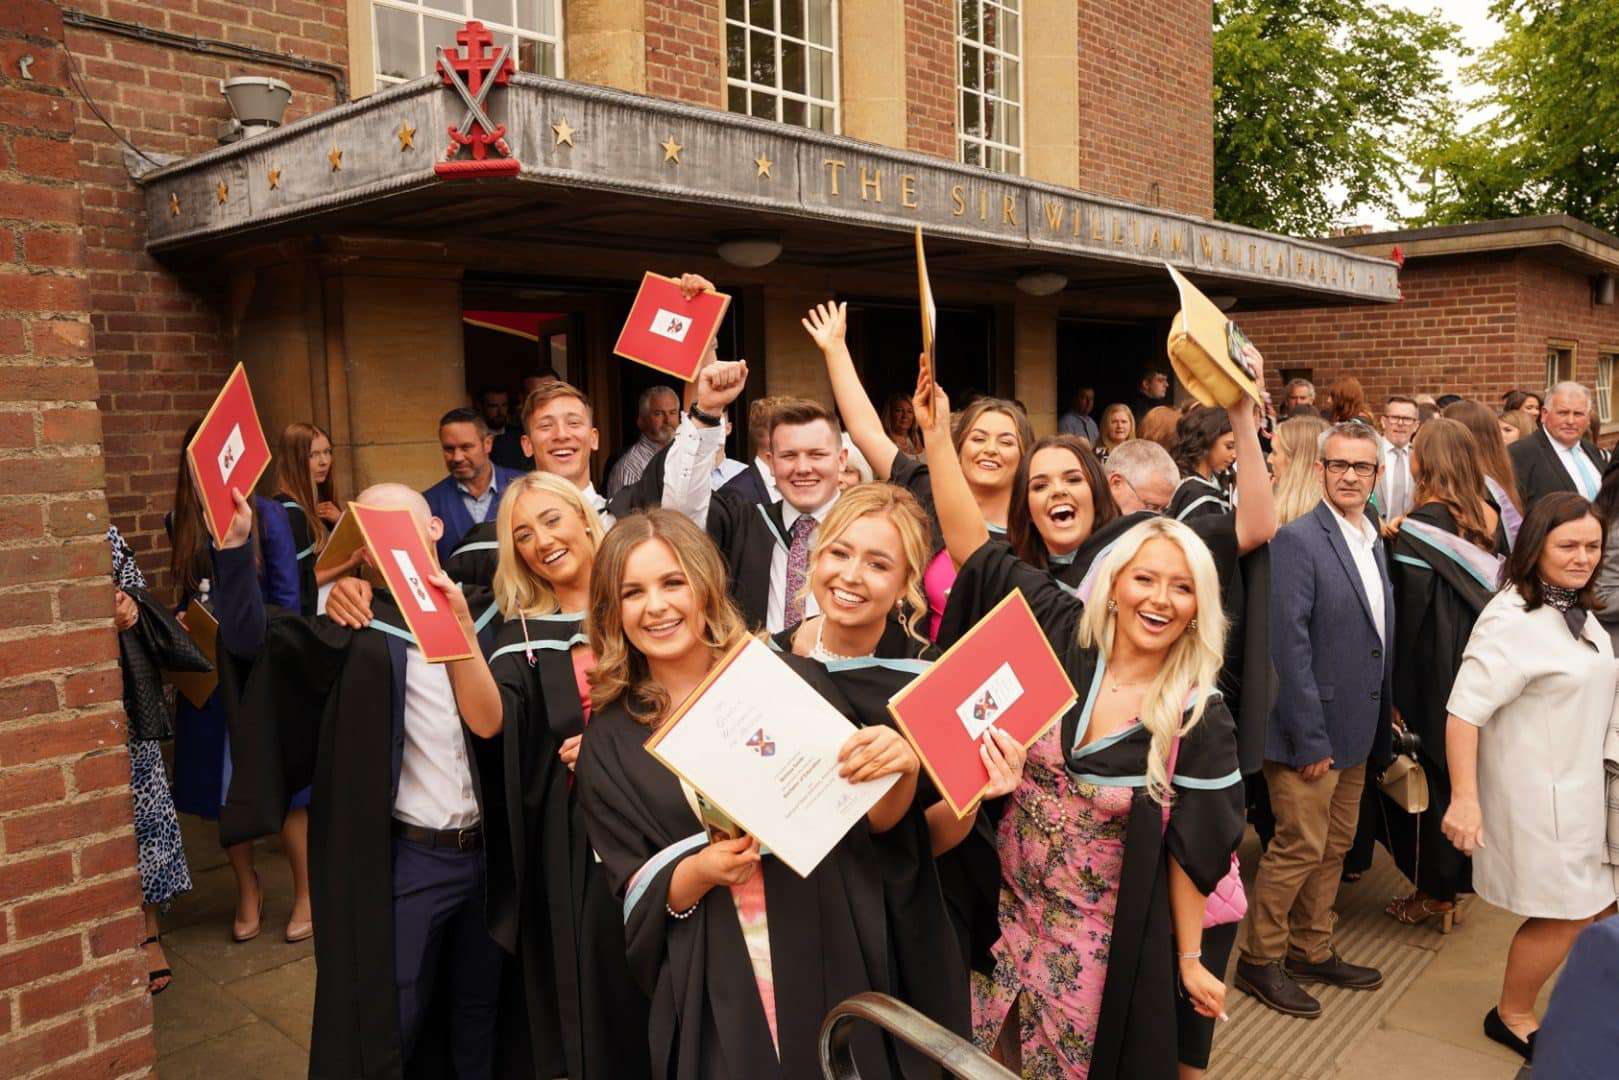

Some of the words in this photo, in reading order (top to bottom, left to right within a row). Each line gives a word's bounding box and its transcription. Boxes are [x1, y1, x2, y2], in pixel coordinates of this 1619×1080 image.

[823, 158, 918, 209] THE
[951, 184, 1019, 226] SIR
[1044, 201, 1184, 252] WILLIAM
